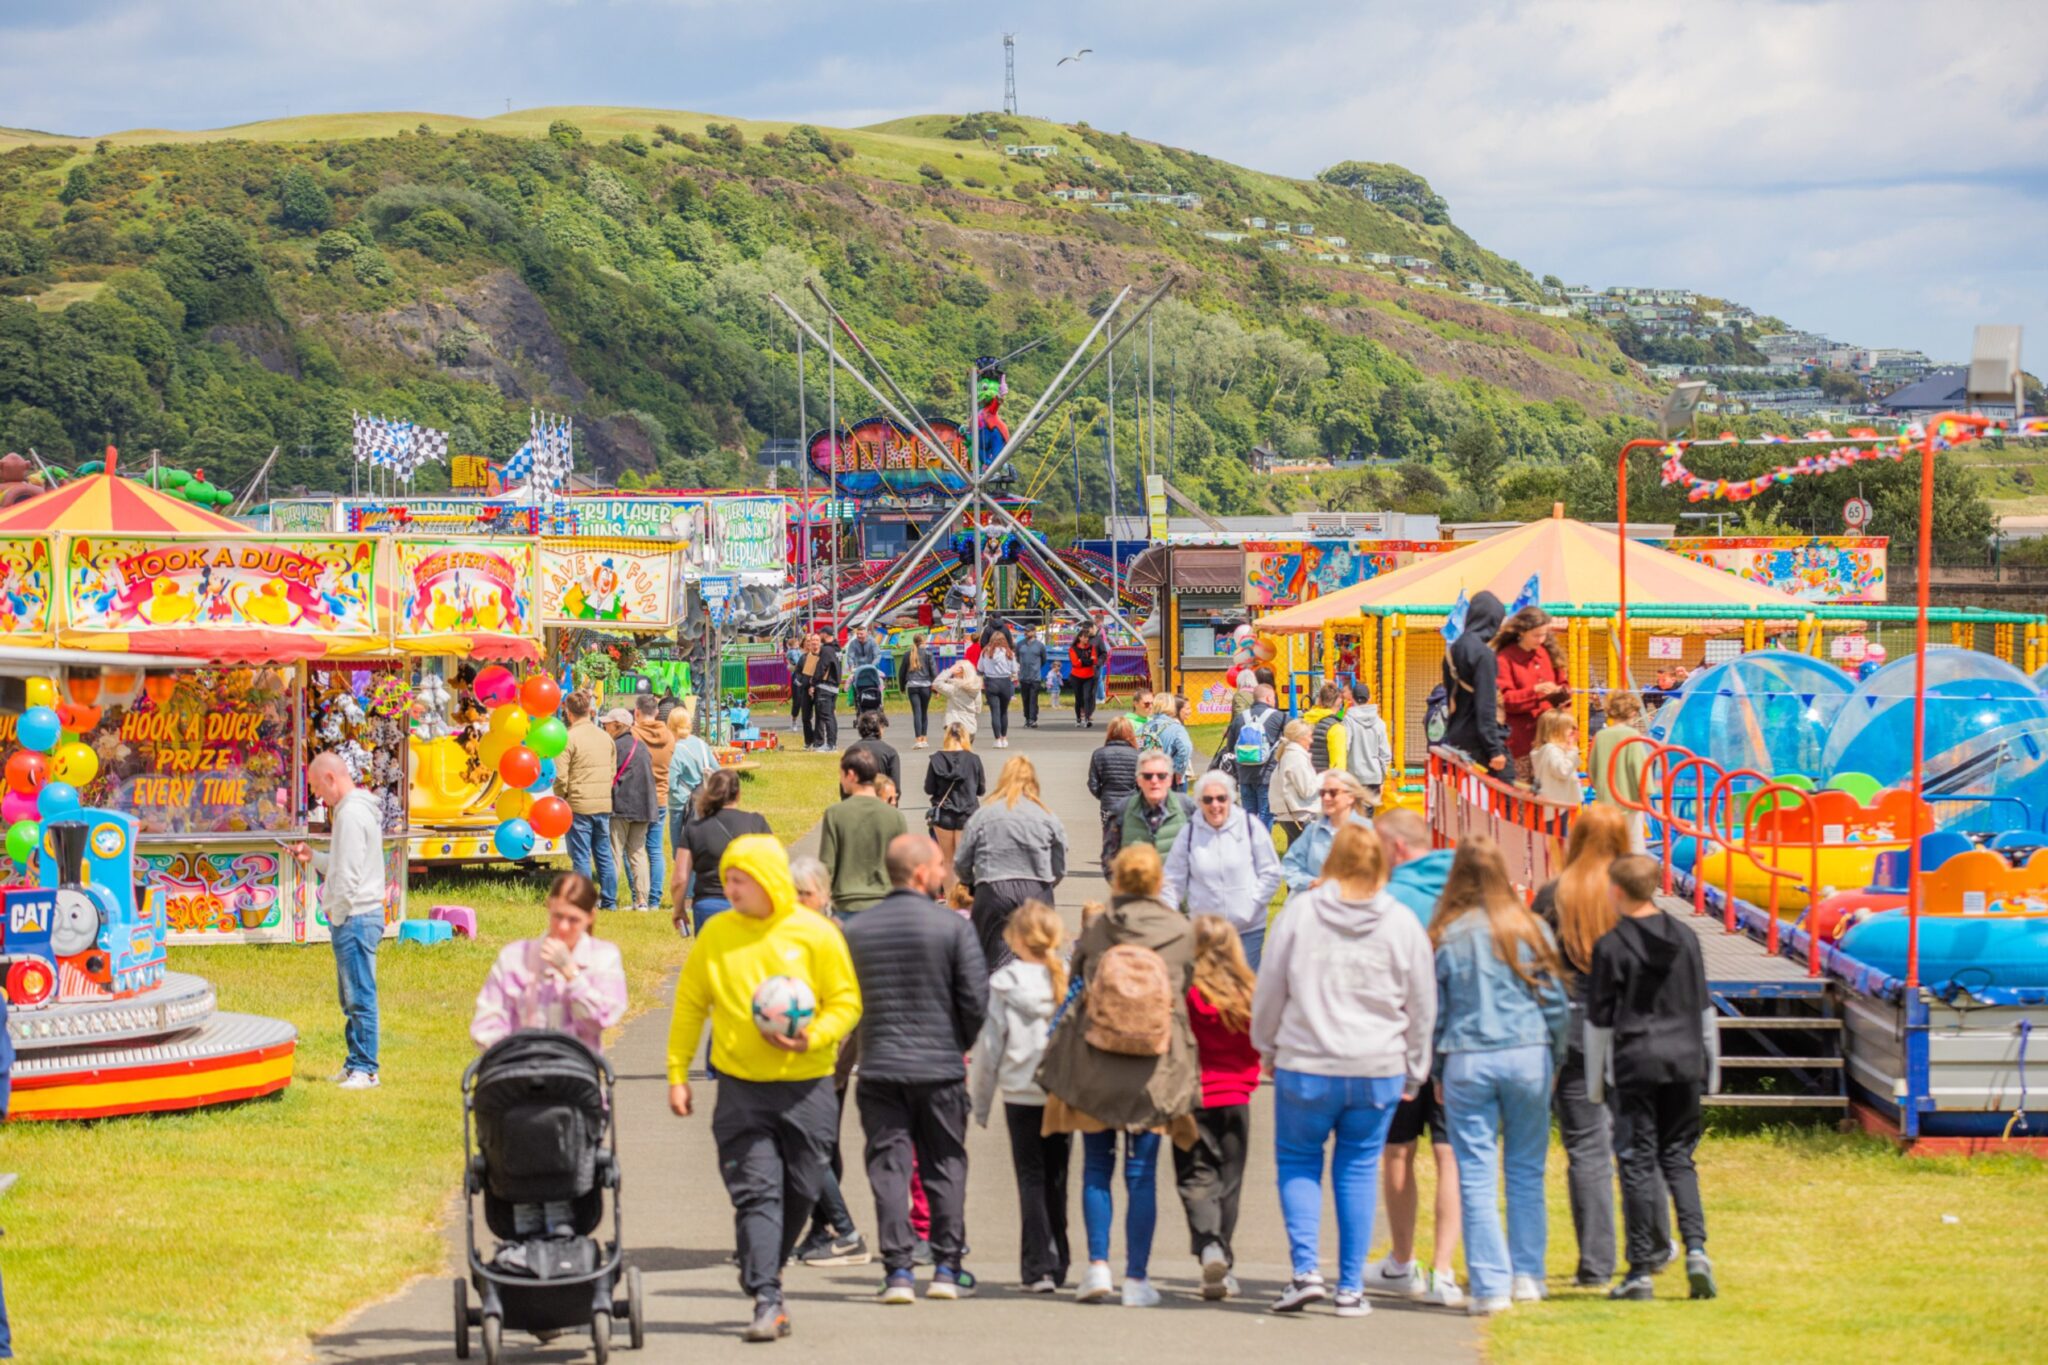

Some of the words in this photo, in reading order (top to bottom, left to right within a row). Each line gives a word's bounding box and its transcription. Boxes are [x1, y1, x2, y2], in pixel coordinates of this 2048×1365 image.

[612, 501, 671, 524] PLAYER
[725, 502, 746, 521] EVERY
[747, 501, 771, 520] PLAYER
[1848, 506, 1860, 518] 65
[728, 520, 752, 540] WINS
[448, 551, 487, 571] EVERY
[725, 540, 772, 566] ELEPHANT
[119, 547, 209, 586] HOOK
[211, 547, 235, 569] A
[238, 547, 325, 590] DUCK
[542, 555, 586, 611] HAVE
[626, 561, 657, 614] FUN
[1661, 641, 1671, 655] 2
[1842, 641, 1852, 653] 3
[121, 712, 180, 742] HOOK
[185, 711, 201, 741] A
[206, 711, 265, 742] DUCK
[155, 748, 232, 772] PRIZE
[133, 777, 196, 807] EVERY
[201, 777, 249, 807] TIME
[10, 901, 52, 934] CAT
